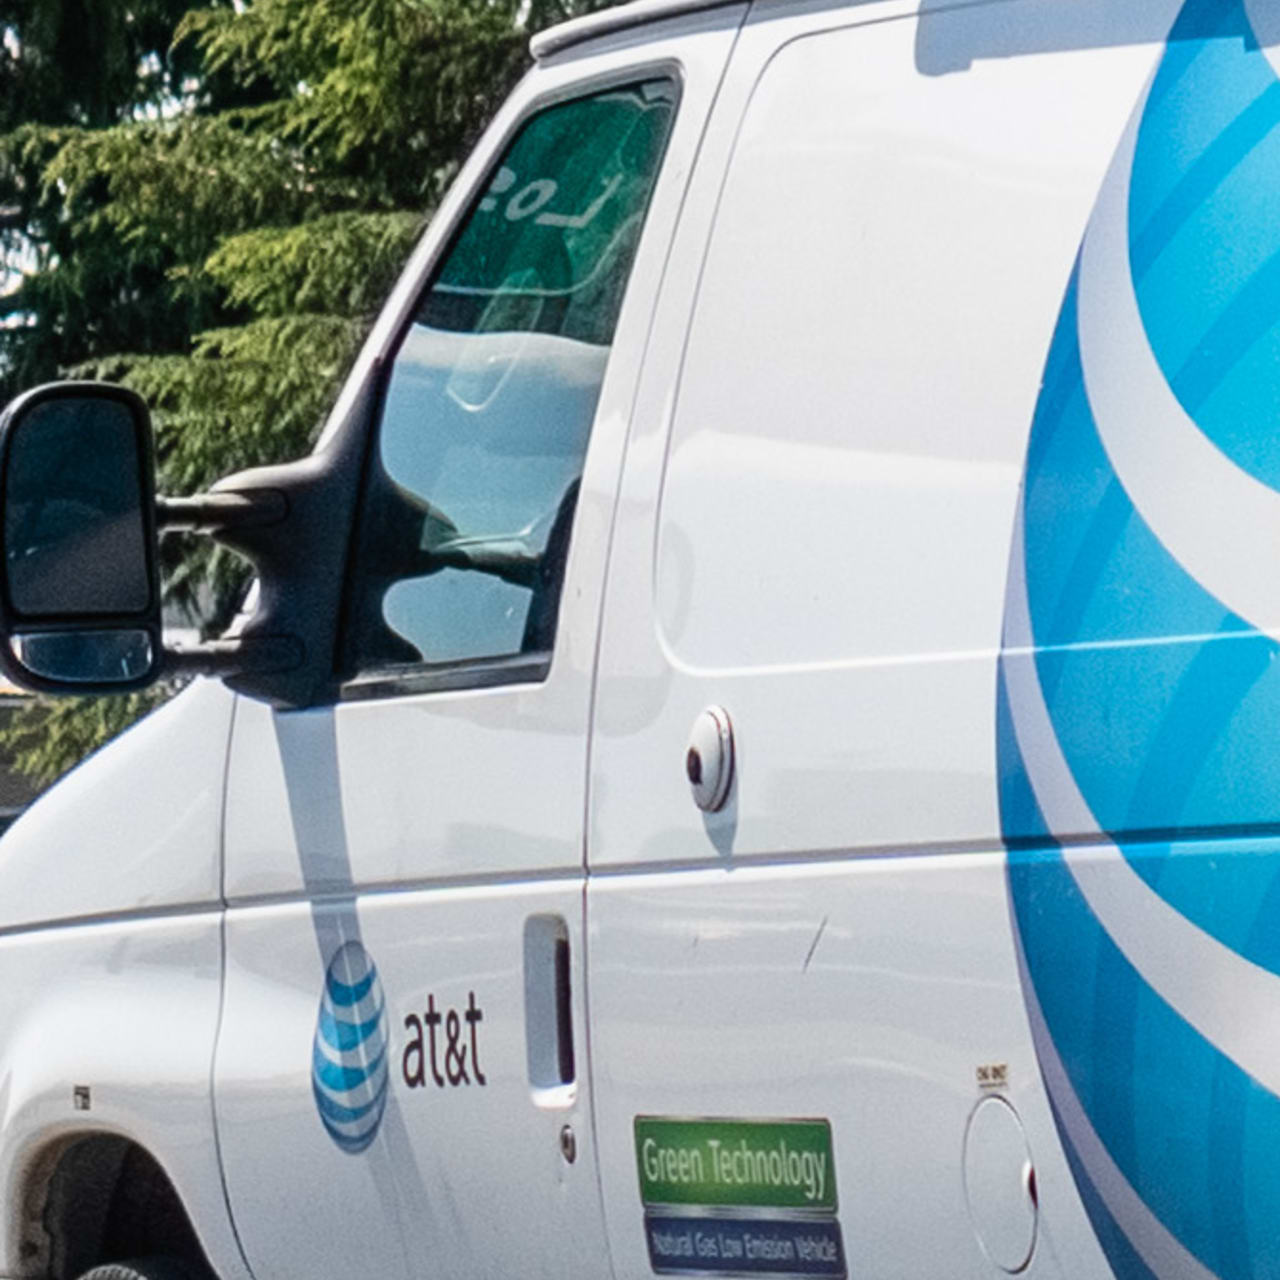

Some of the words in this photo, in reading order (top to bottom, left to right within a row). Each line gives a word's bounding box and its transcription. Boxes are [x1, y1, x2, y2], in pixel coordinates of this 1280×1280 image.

[402, 989, 487, 1089] at&t
[642, 1137, 704, 1184] Green
[707, 1139, 827, 1200] Technology
